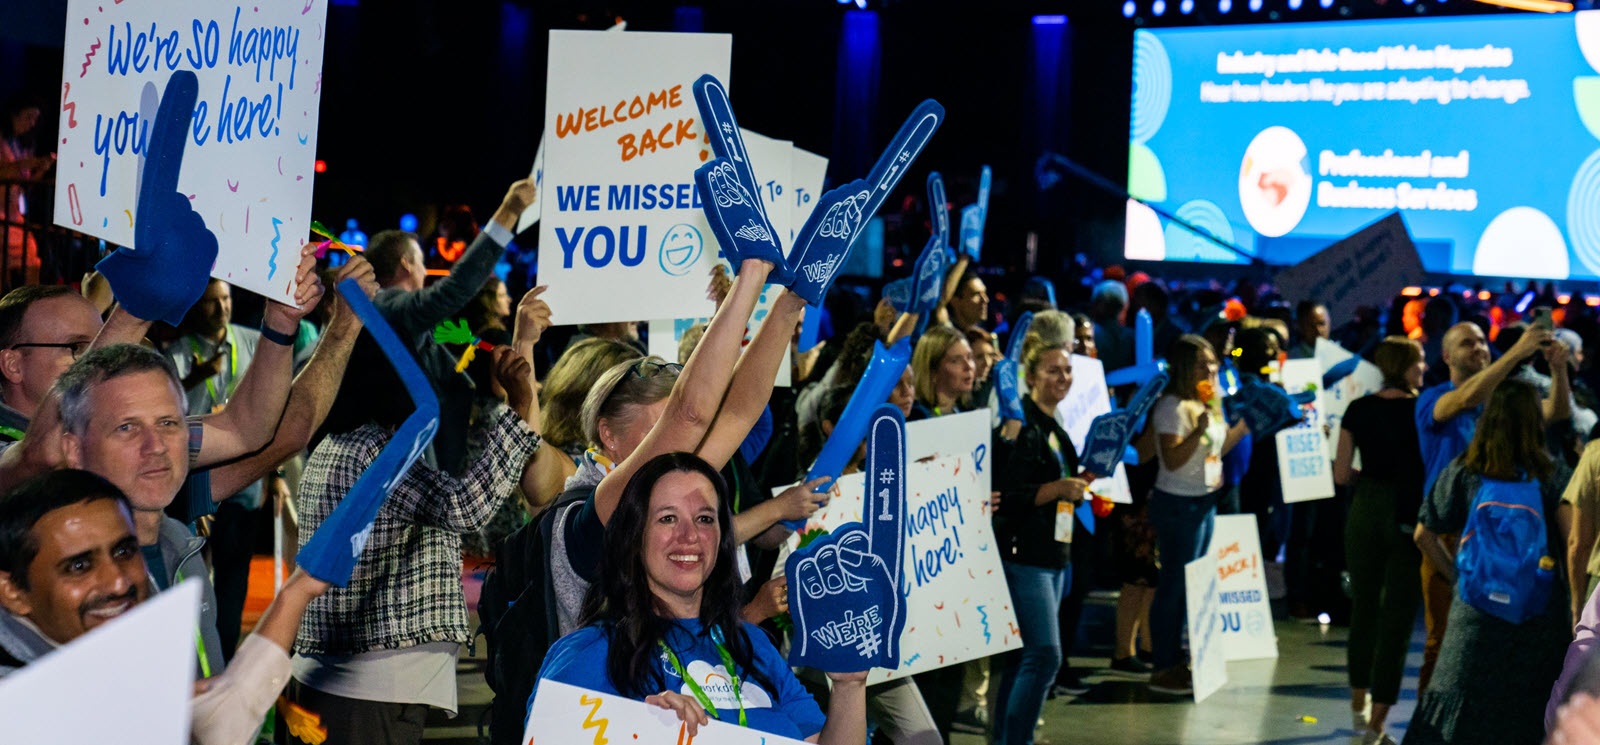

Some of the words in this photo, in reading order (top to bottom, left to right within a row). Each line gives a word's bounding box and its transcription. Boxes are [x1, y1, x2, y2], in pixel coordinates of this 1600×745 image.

[108, 22, 182, 76] We're
[228, 6, 300, 90] happy
[94, 100, 211, 197] youe
[217, 75, 283, 144] here!
[555, 84, 683, 139] WELCOME
[556, 185, 600, 212] WE
[554, 225, 648, 269] YOU
[905, 486, 964, 538] happy
[911, 525, 963, 587] here!
[811, 605, 882, 650] WE'RE
